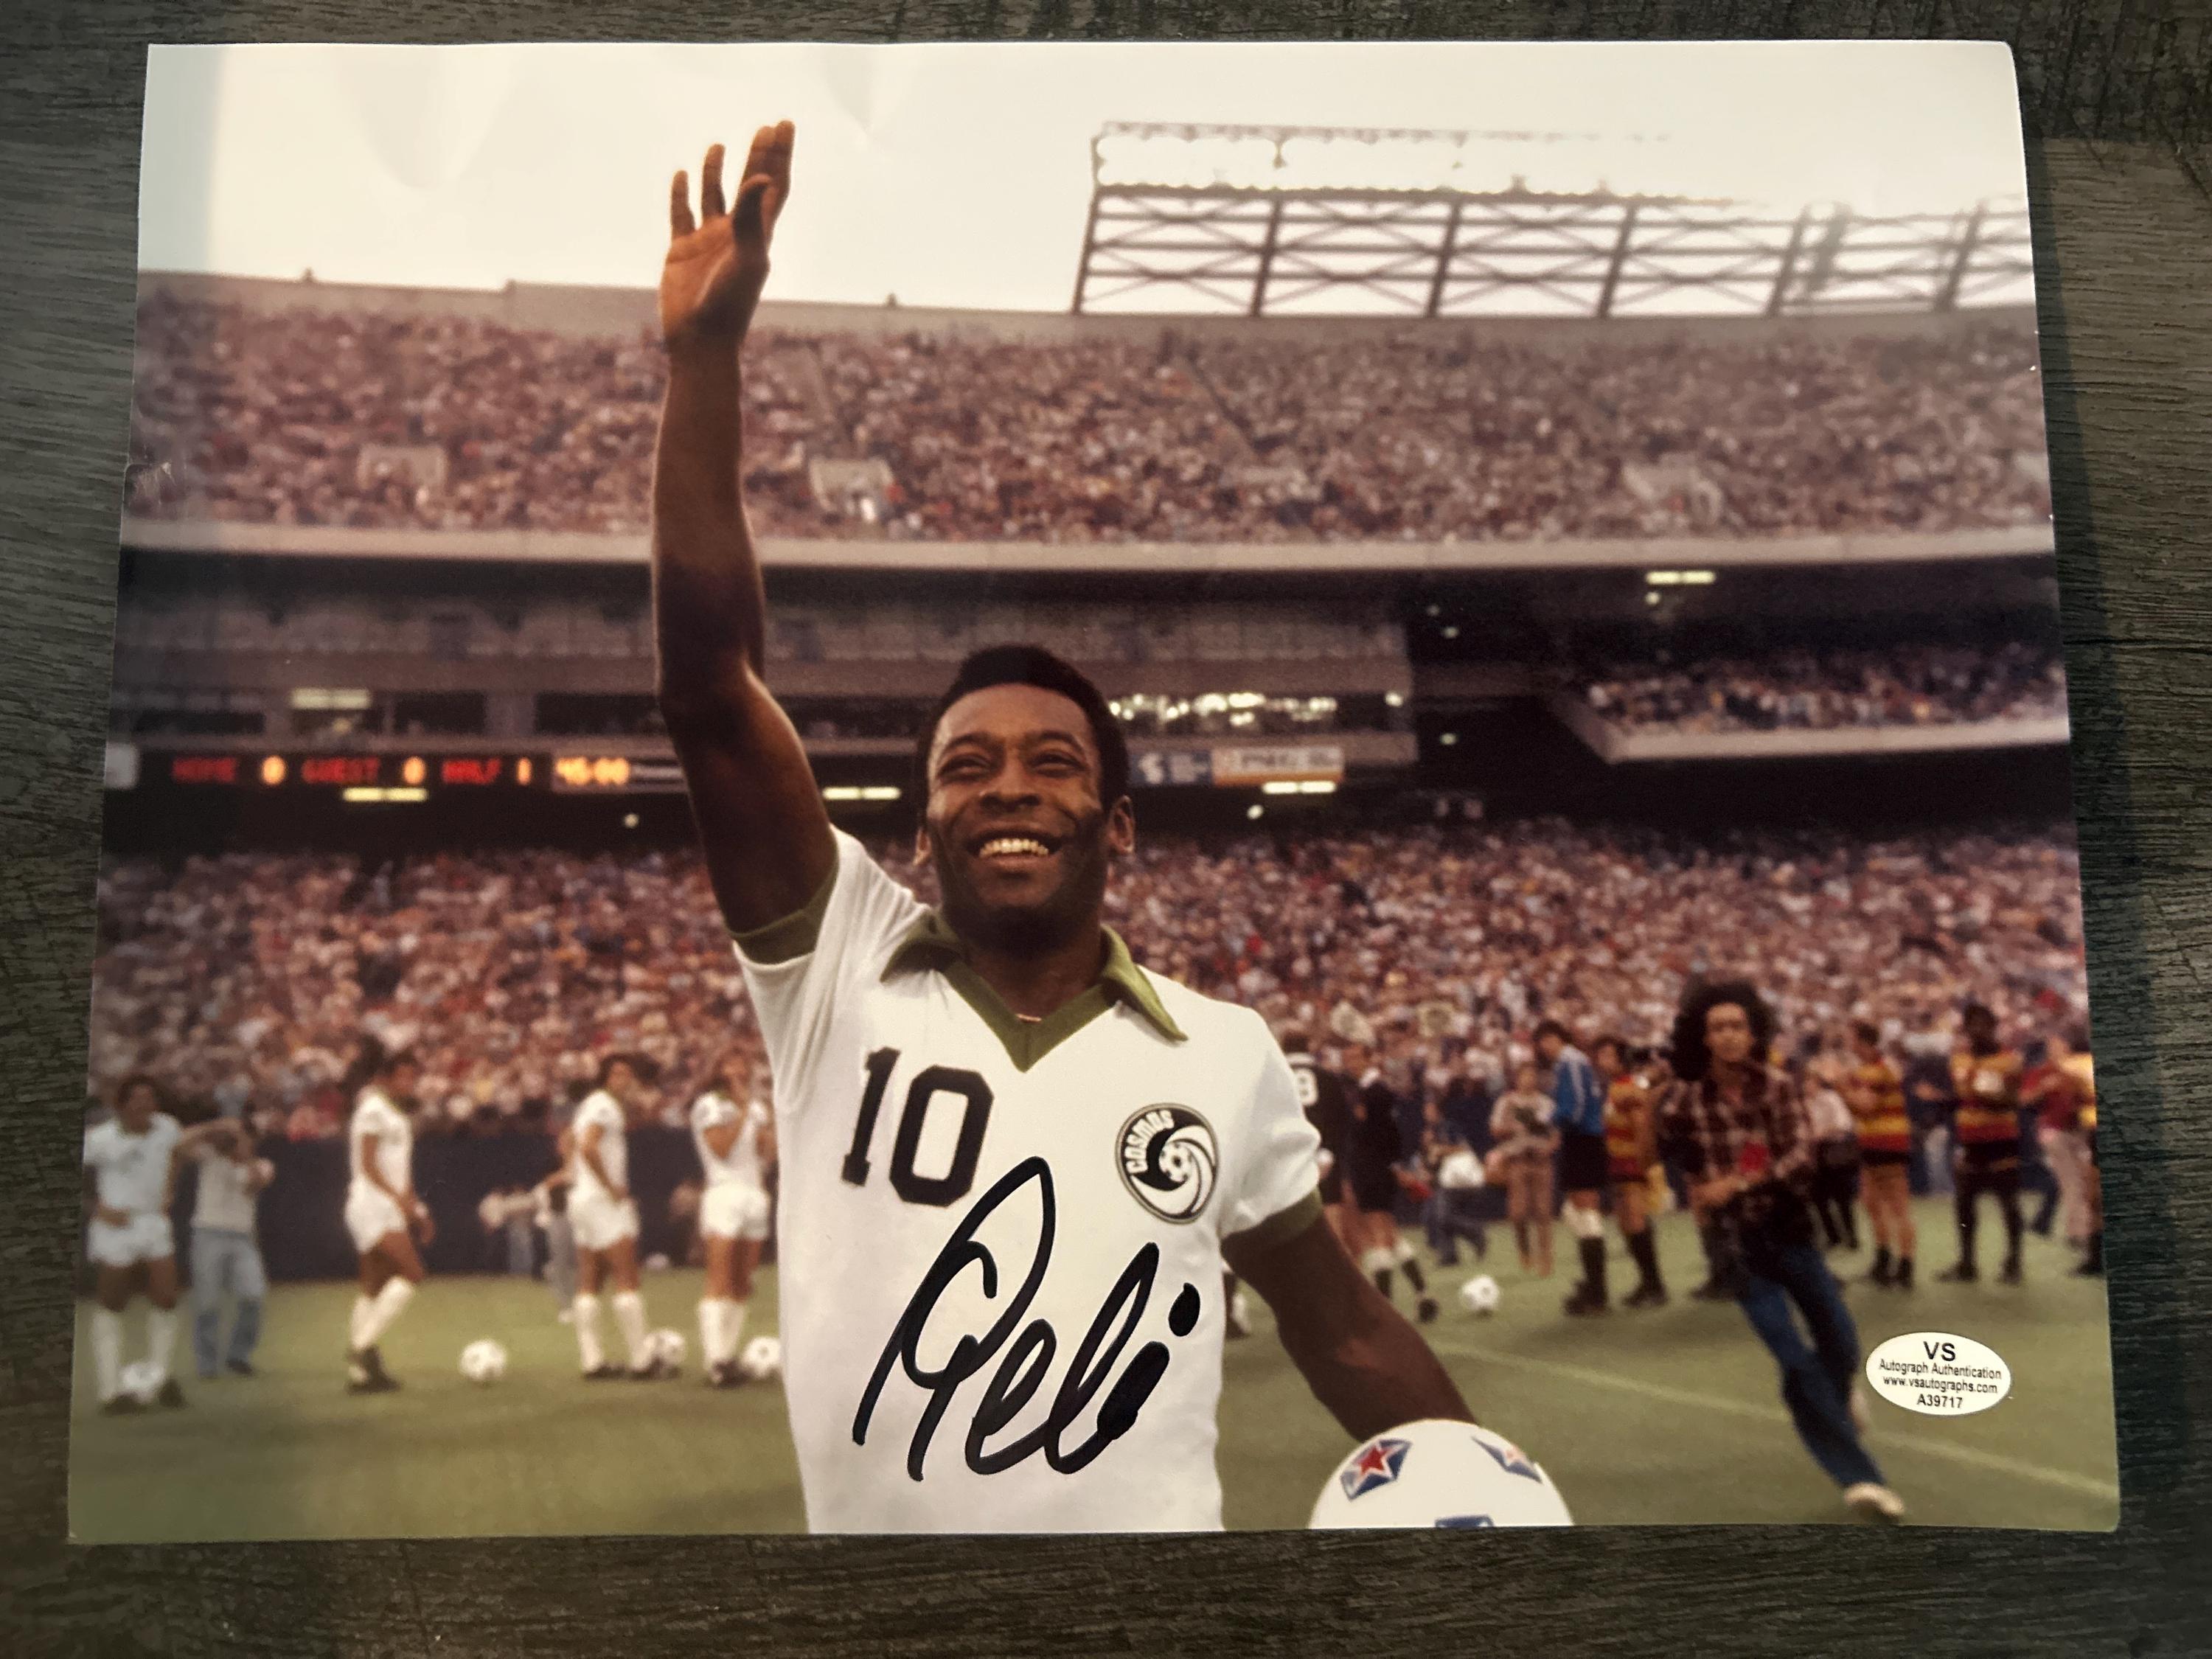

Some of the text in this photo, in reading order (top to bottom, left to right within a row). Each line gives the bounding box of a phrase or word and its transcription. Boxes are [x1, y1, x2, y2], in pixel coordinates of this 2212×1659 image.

[841, 1046, 995, 1208] 10
[1923, 1340, 1956, 1362] VS
[1879, 1358, 2002, 1380] Autograph Authentication
[1882, 1375, 1997, 1394] www.vsautographs.com
[1916, 1393, 1963, 1409] A39717
